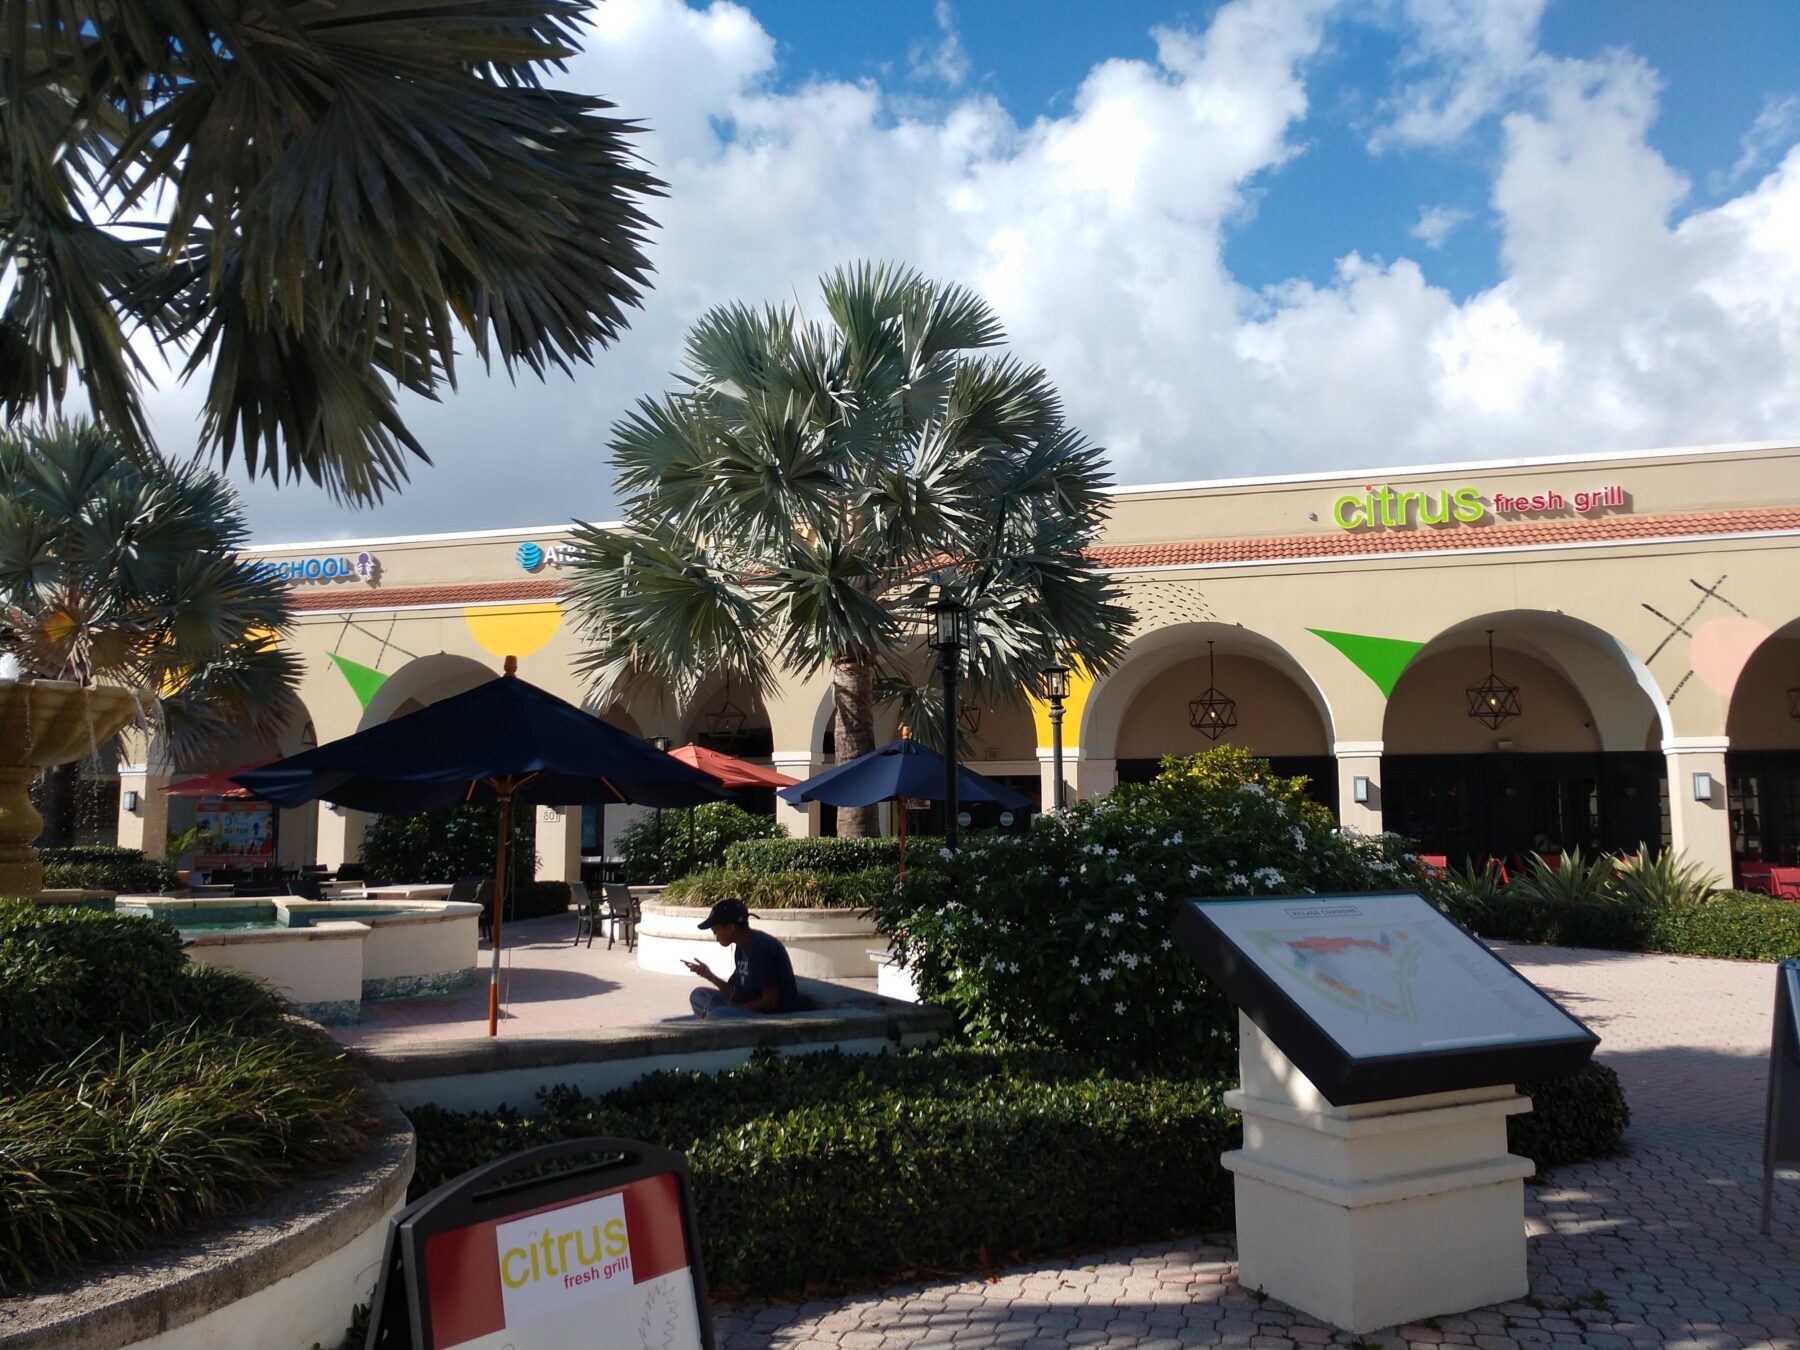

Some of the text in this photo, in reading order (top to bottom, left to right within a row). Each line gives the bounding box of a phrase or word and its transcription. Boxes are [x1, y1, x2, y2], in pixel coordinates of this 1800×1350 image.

[1333, 484, 1623, 529] citrus fresh grill
[501, 1219, 628, 1289] citrus
[564, 1256, 629, 1289] fresh grill
